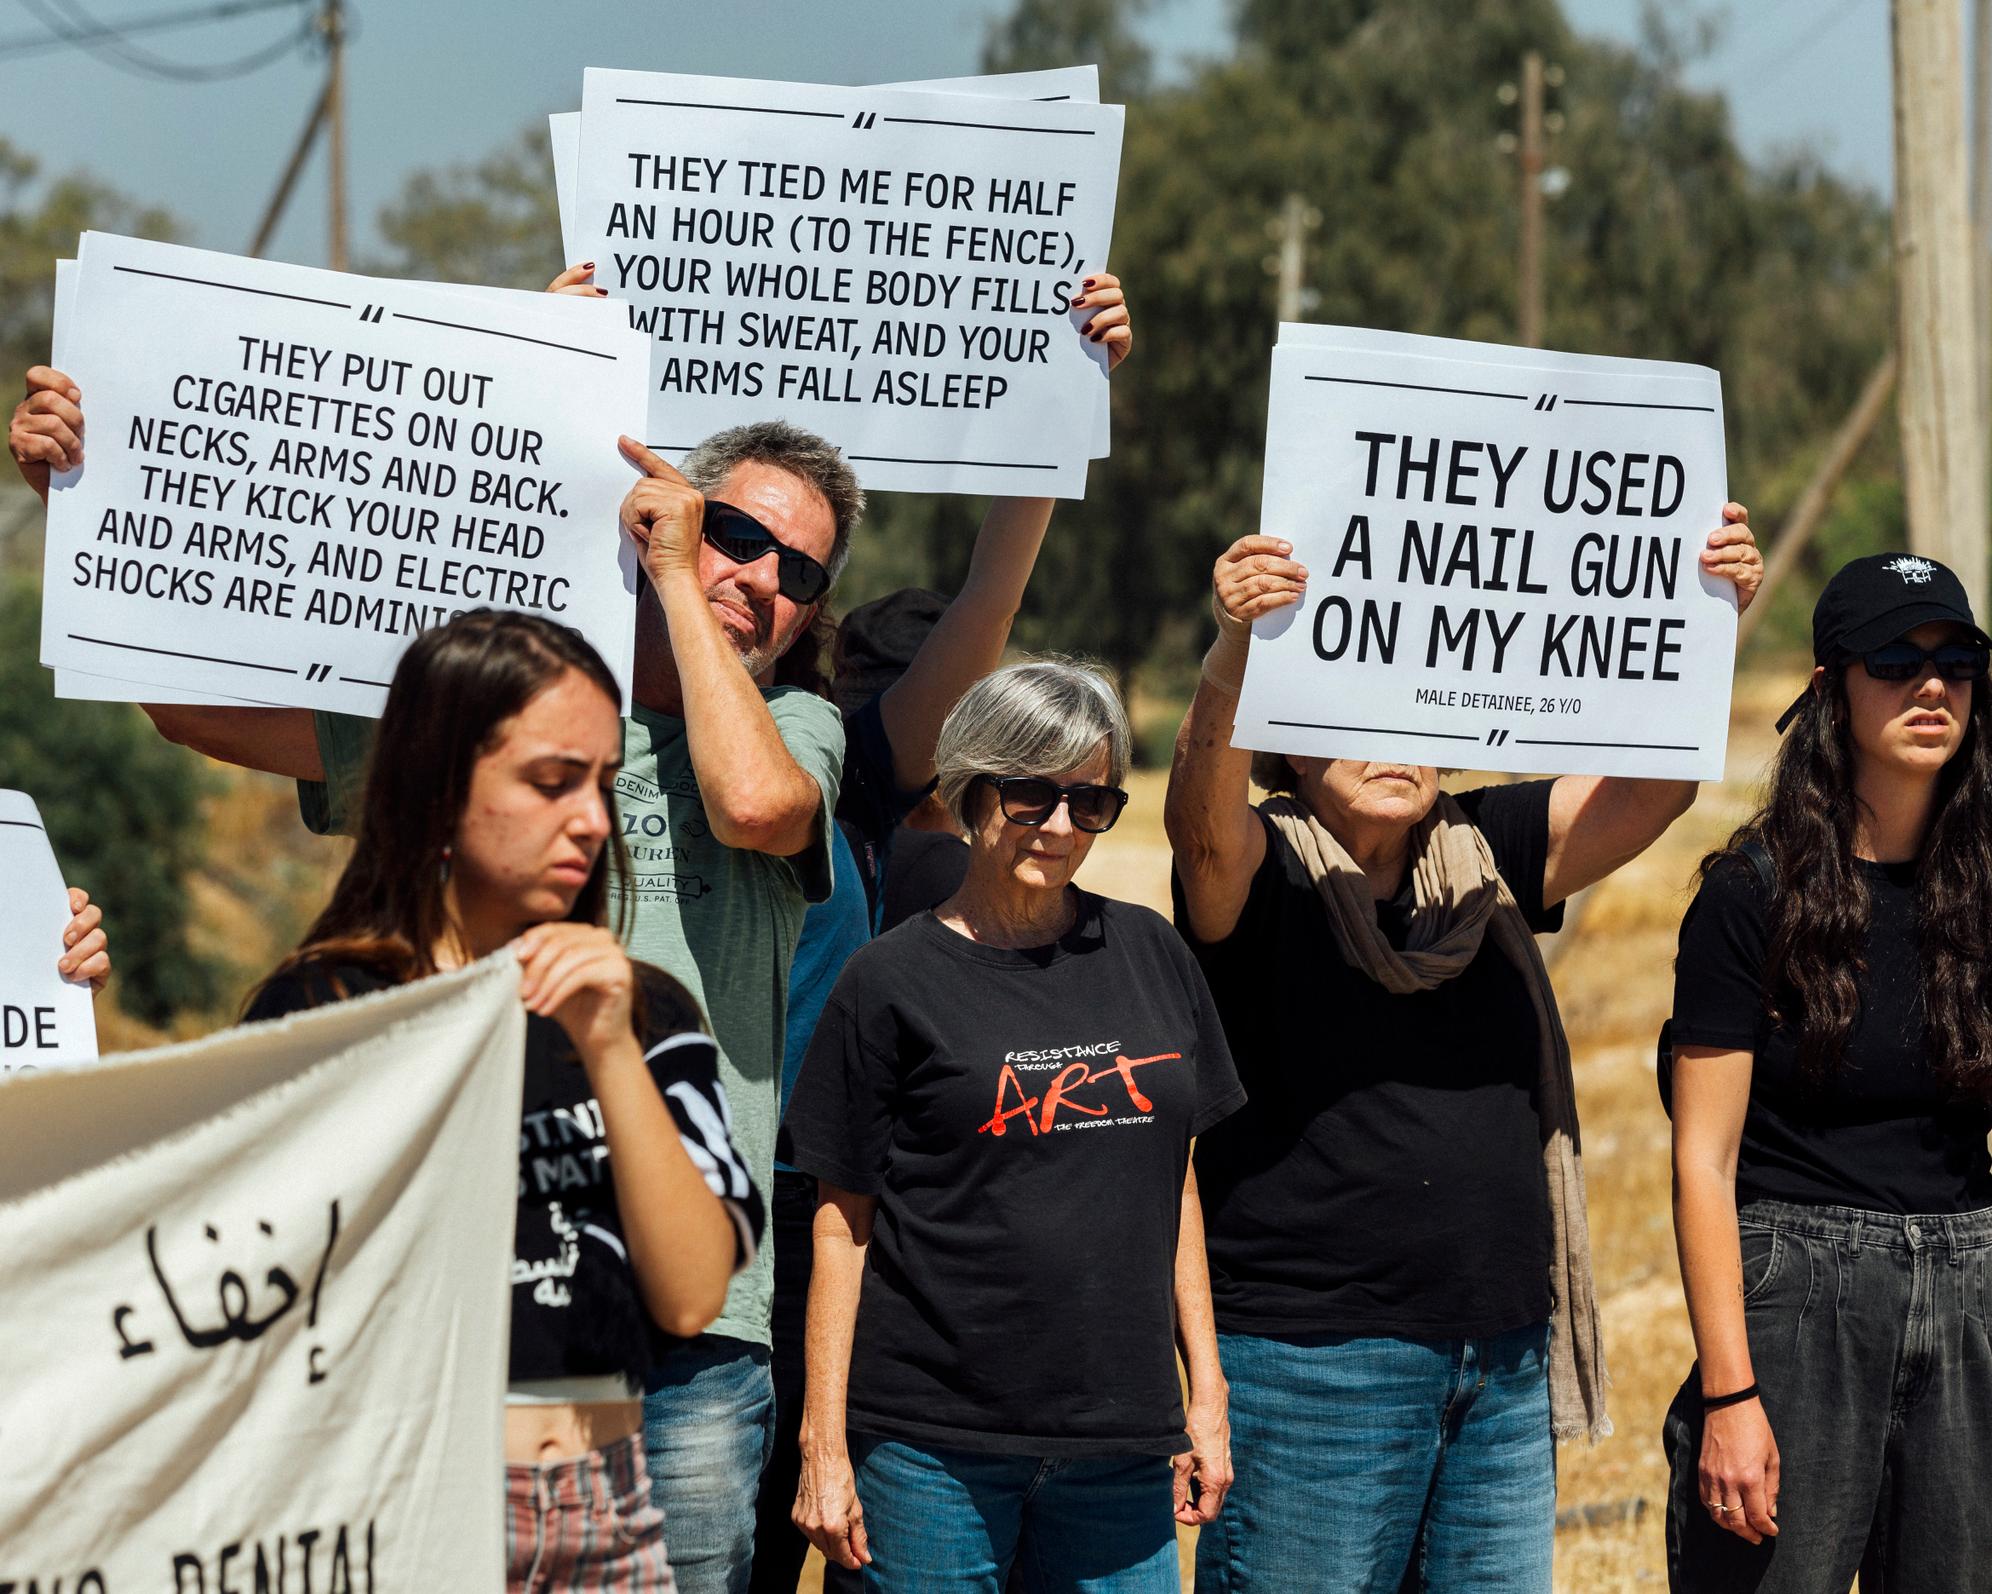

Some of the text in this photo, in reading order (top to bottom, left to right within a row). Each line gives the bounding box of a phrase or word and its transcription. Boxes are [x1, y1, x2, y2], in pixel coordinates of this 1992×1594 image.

[629, 153, 1076, 216] THEY TIED ME FOR HALF
[606, 203, 1085, 274] AN HOUR (TO THE FENCE),
[614, 254, 1073, 315] YOUR WHOLE BODY FILLS
[629, 304, 1049, 363] WITH SWEAT, AND YOUR
[239, 336, 493, 408] THEY PUT OUT
[660, 358, 1007, 409] ARMS FALL ASLEEP
[174, 375, 542, 465] CIGARETTES ON OUR
[129, 416, 568, 517] NECKS, ARMS AND BACK.
[1355, 431, 1684, 517] THEY USED
[141, 465, 544, 559] THEY KICK YOUR HEAD
[97, 509, 569, 611] AND ARMS, AND ELECTRIC
[1332, 515, 1681, 599] A NAIL GUN
[74, 552, 466, 638] SHOCKS ARE ADMINI
[1313, 596, 1685, 681] ON MY KNEE
[1415, 688, 1457, 707] MALE
[1462, 692, 1536, 715] DETAINEE,
[1539, 697, 1556, 713] 26
[616, 777, 660, 800] DENIM
[625, 845, 691, 863] UREN
[1004, 1040, 1122, 1063] RESISTANCE
[977, 1052, 1182, 1137] ART
[1073, 1118, 1115, 1130] FREEDOM
